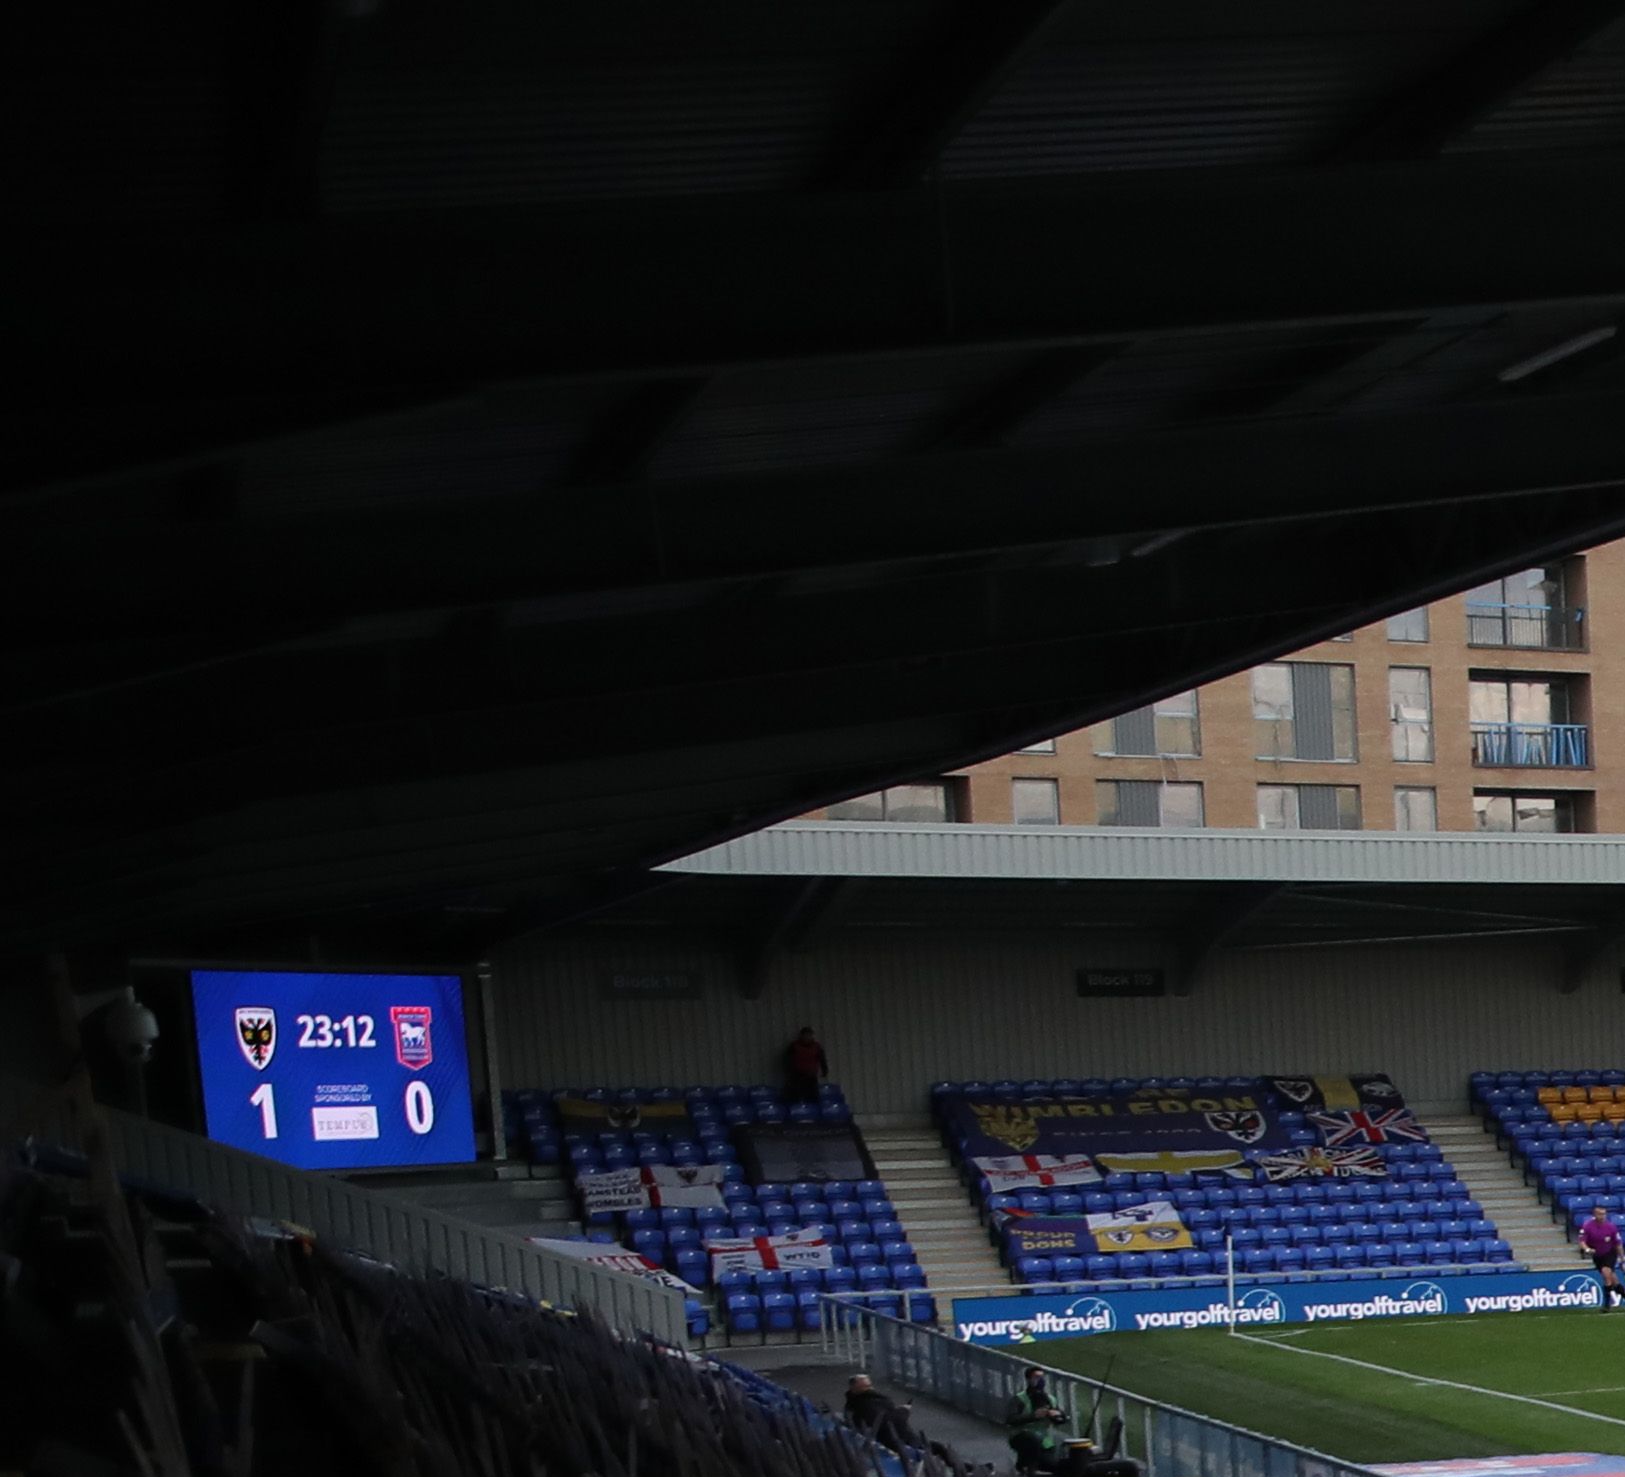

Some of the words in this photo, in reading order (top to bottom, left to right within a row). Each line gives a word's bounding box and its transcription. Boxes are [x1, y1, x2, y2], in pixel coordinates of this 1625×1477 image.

[1087, 973, 1130, 985] Block
[296, 1014, 376, 1048] 23:12
[250, 1083, 279, 1140] 1
[404, 1080, 435, 1136] 0
[1135, 1301, 1280, 1331] yourgolftravel
[1304, 1298, 1442, 1323] yourgolftravel
[1465, 1289, 1599, 1314] yourgolftravel
